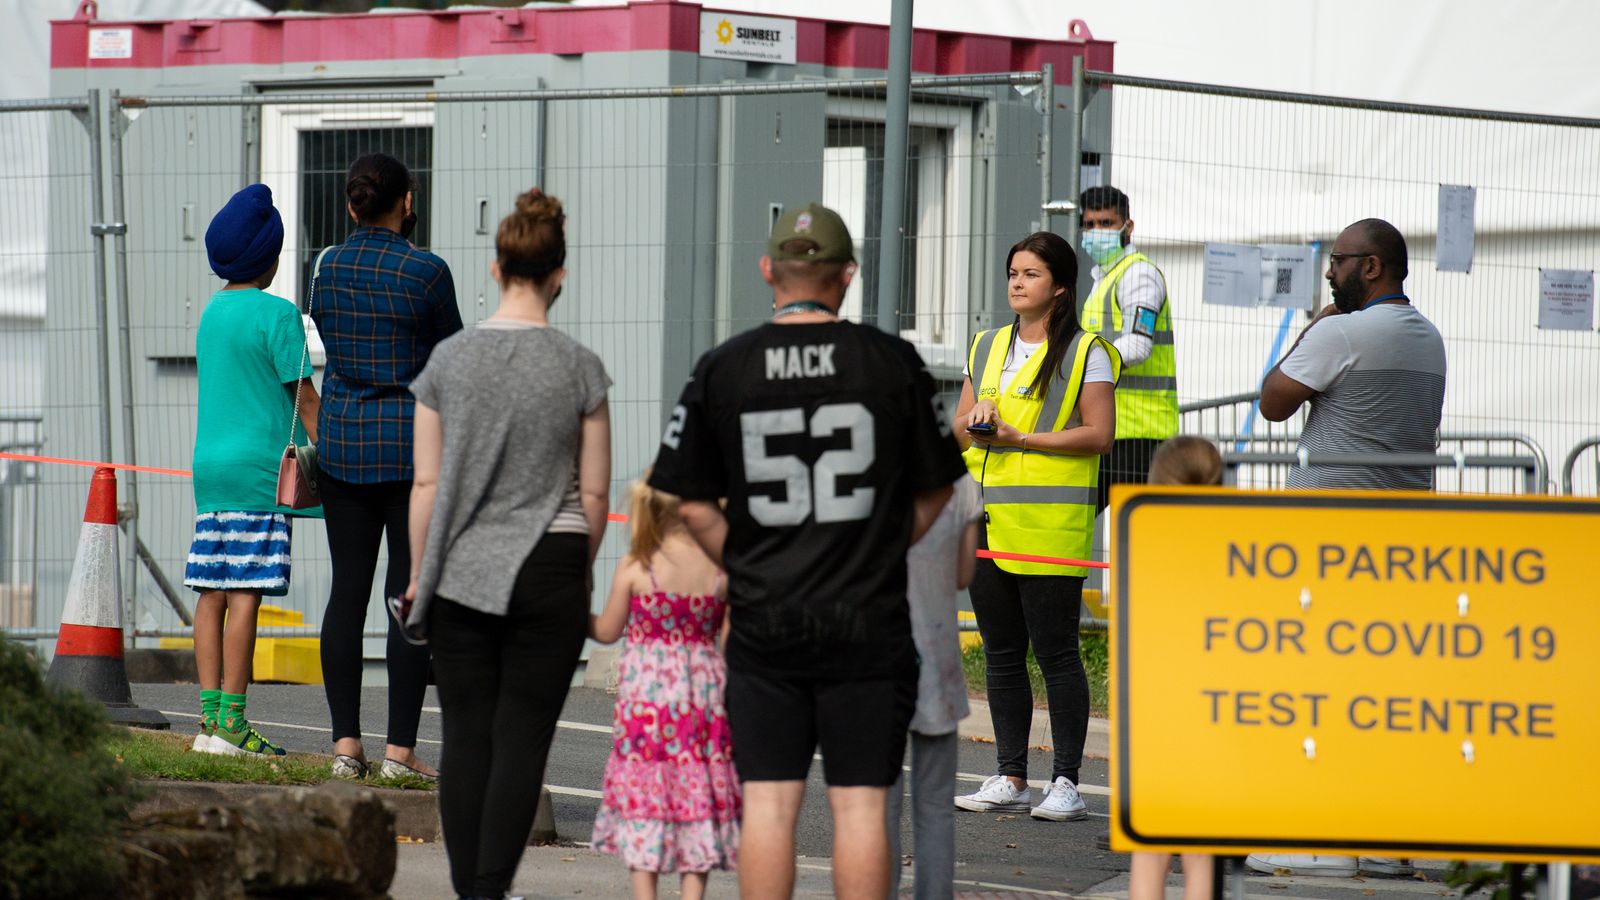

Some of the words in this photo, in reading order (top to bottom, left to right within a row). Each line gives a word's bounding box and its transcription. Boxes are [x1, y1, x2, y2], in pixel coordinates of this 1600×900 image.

[736, 27, 781, 42] SUNBELT
[765, 343, 836, 380] MACK
[662, 404, 688, 450] 2
[740, 402, 877, 527] 52
[1227, 542, 1299, 580] NO
[1317, 544, 1547, 586] PARKING
[1204, 617, 1307, 654] FOR
[1325, 620, 1484, 659] COVID
[1503, 624, 1557, 662] 19
[1200, 689, 1329, 728] TEST
[1347, 695, 1556, 739] CENTRE
